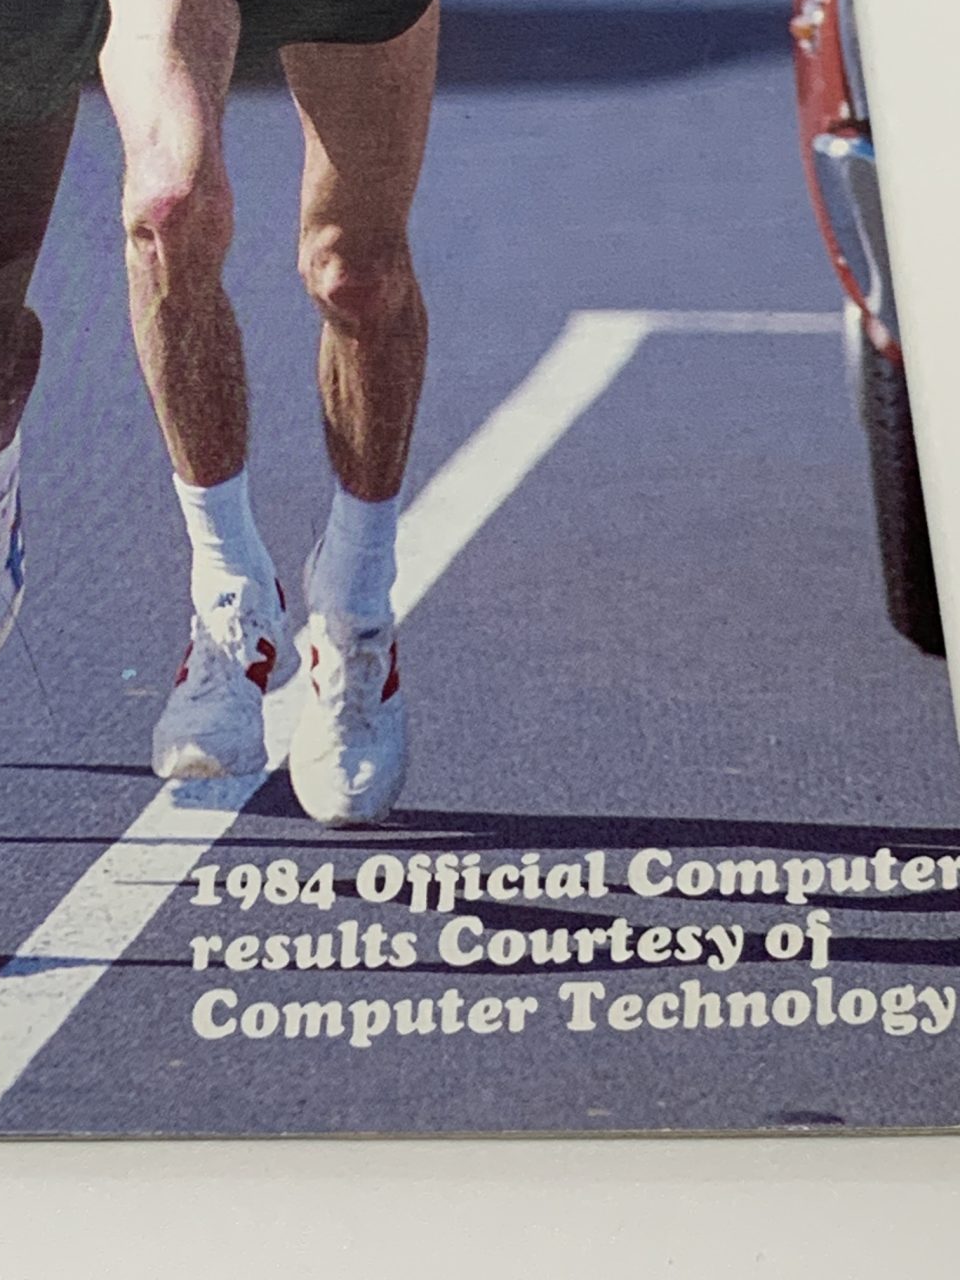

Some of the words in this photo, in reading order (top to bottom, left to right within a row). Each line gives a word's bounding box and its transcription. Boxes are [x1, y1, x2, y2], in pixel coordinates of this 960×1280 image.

[190, 860, 336, 910] 1984
[356, 852, 607, 913] Official
[628, 847, 960, 904] Computer
[190, 921, 418, 972] results
[439, 916, 746, 971] Courtesy
[765, 909, 834, 969] of
[191, 988, 539, 1048] Computer
[559, 977, 957, 1037] Technology
